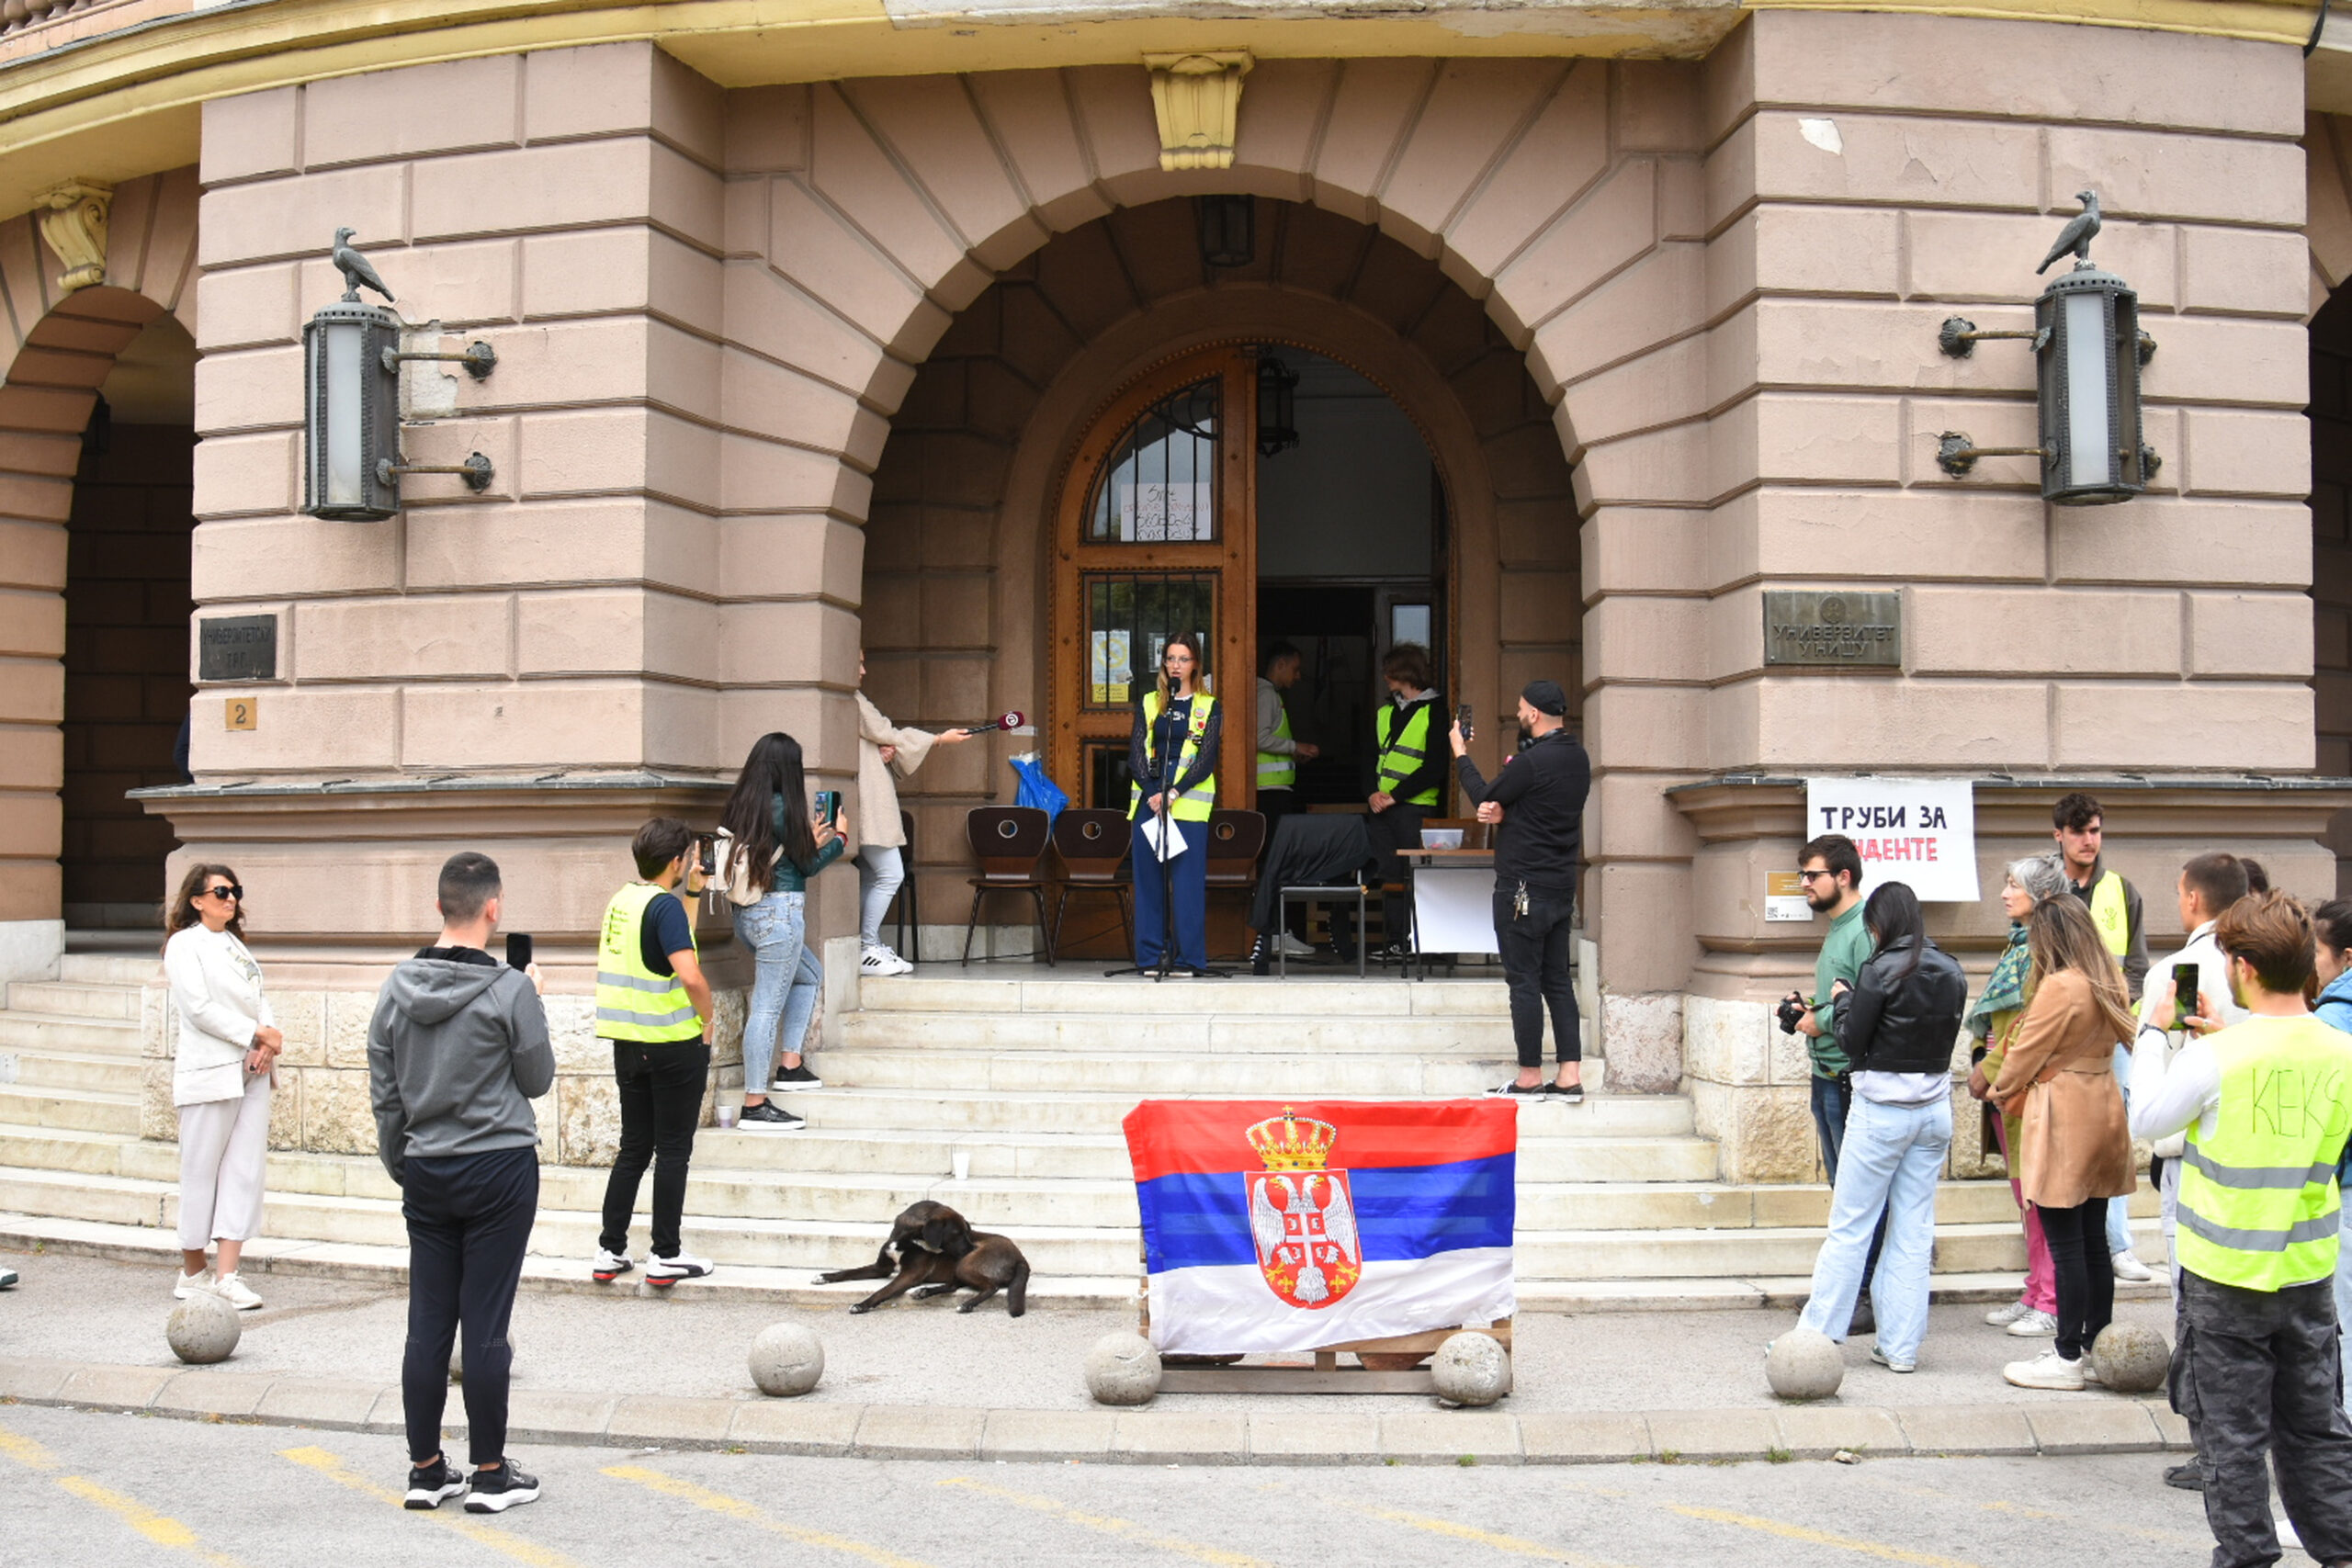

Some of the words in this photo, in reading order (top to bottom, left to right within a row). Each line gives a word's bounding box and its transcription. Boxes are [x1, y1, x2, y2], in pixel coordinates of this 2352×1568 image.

[1772, 624, 1894, 641] УНИВЕРЗИТЕТ
[1798, 641, 1810, 657] У
[1815, 641, 1867, 657] НИШУ
[235, 705, 247, 724] 2
[1820, 806, 1905, 829] ТРУБИ
[1918, 805, 1947, 829] ЗА
[2252, 1068, 2348, 1139] KEKS
